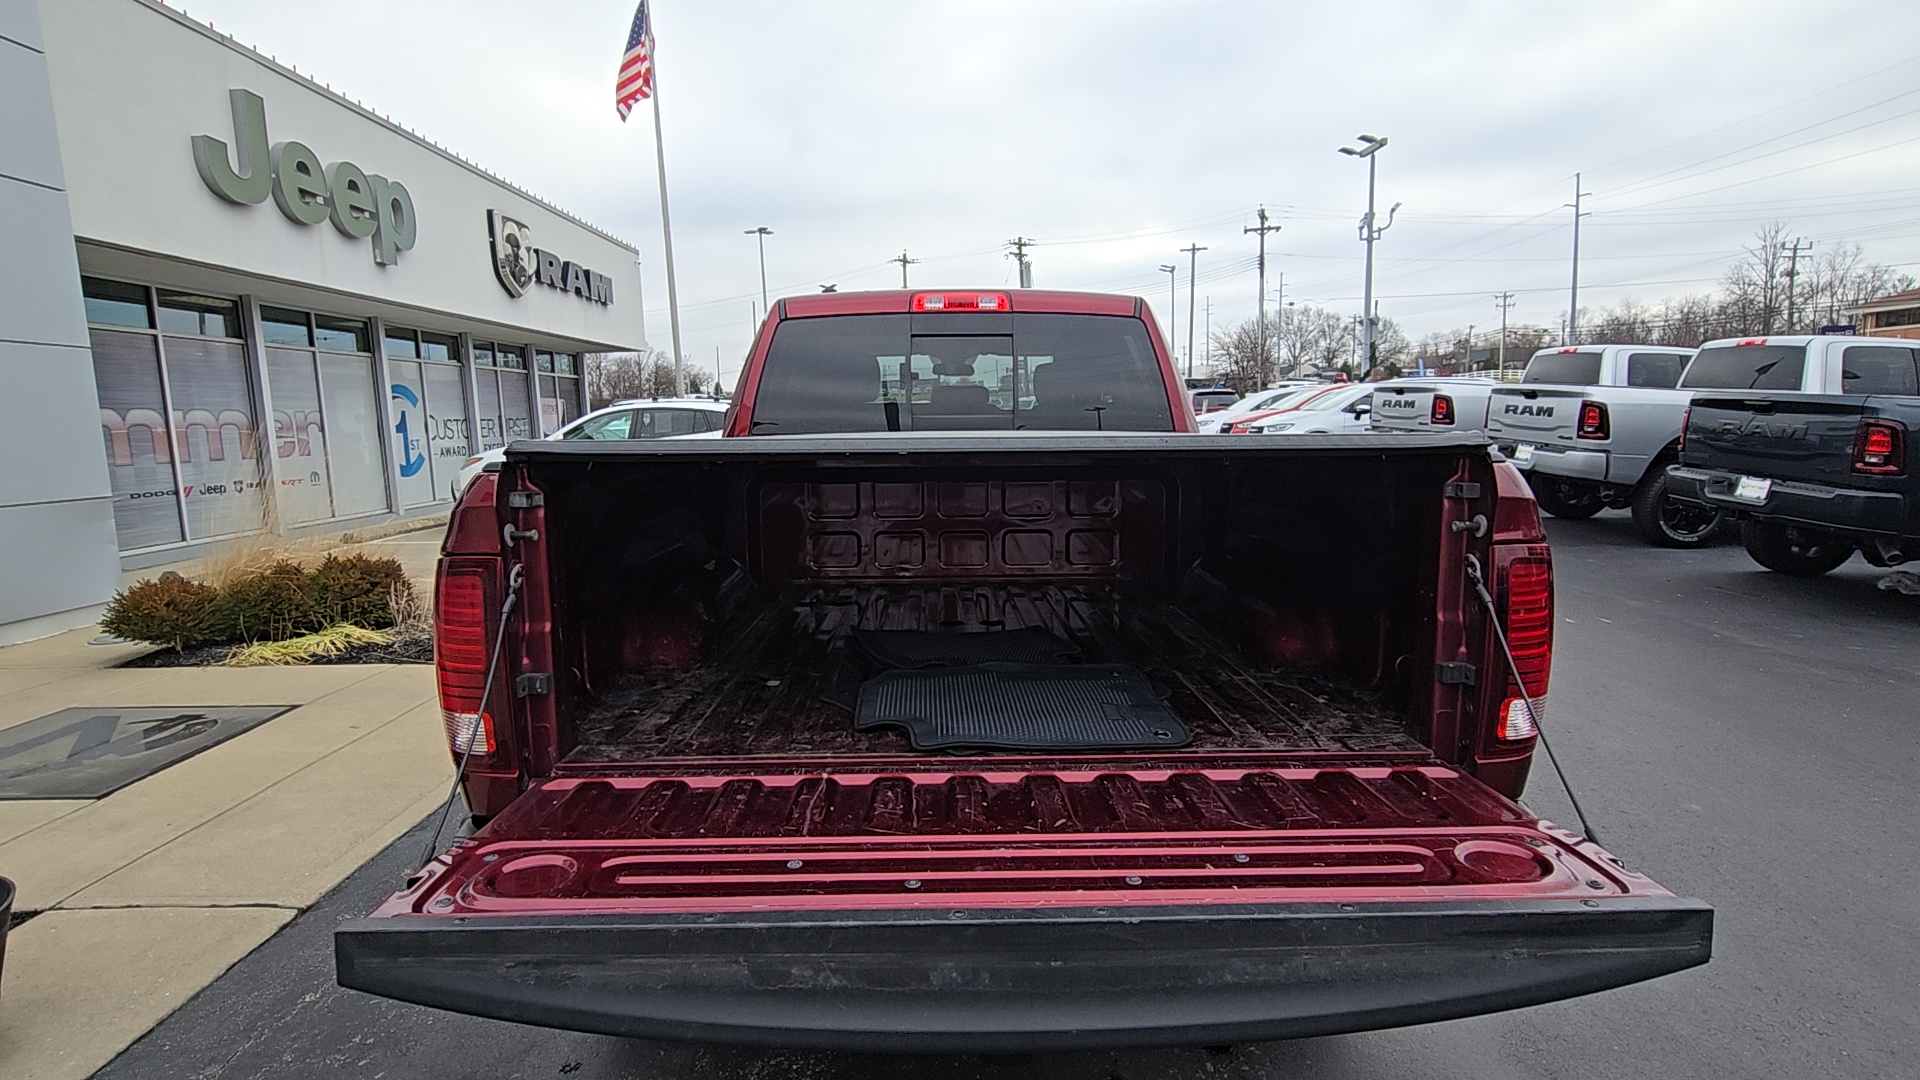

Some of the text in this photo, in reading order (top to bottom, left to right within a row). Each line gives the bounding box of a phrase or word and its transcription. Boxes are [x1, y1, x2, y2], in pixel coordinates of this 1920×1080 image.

[191, 88, 417, 266] Jeep
[533, 247, 614, 306] RAM
[1382, 399, 1416, 409] RAM
[1504, 404, 1554, 418] RAM
[425, 414, 497, 441] CUSTOER
[1717, 419, 1809, 441] RAM
[440, 446, 467, 458] AWARD
[129, 490, 178, 499] DODG
[199, 483, 226, 496] Jeep
